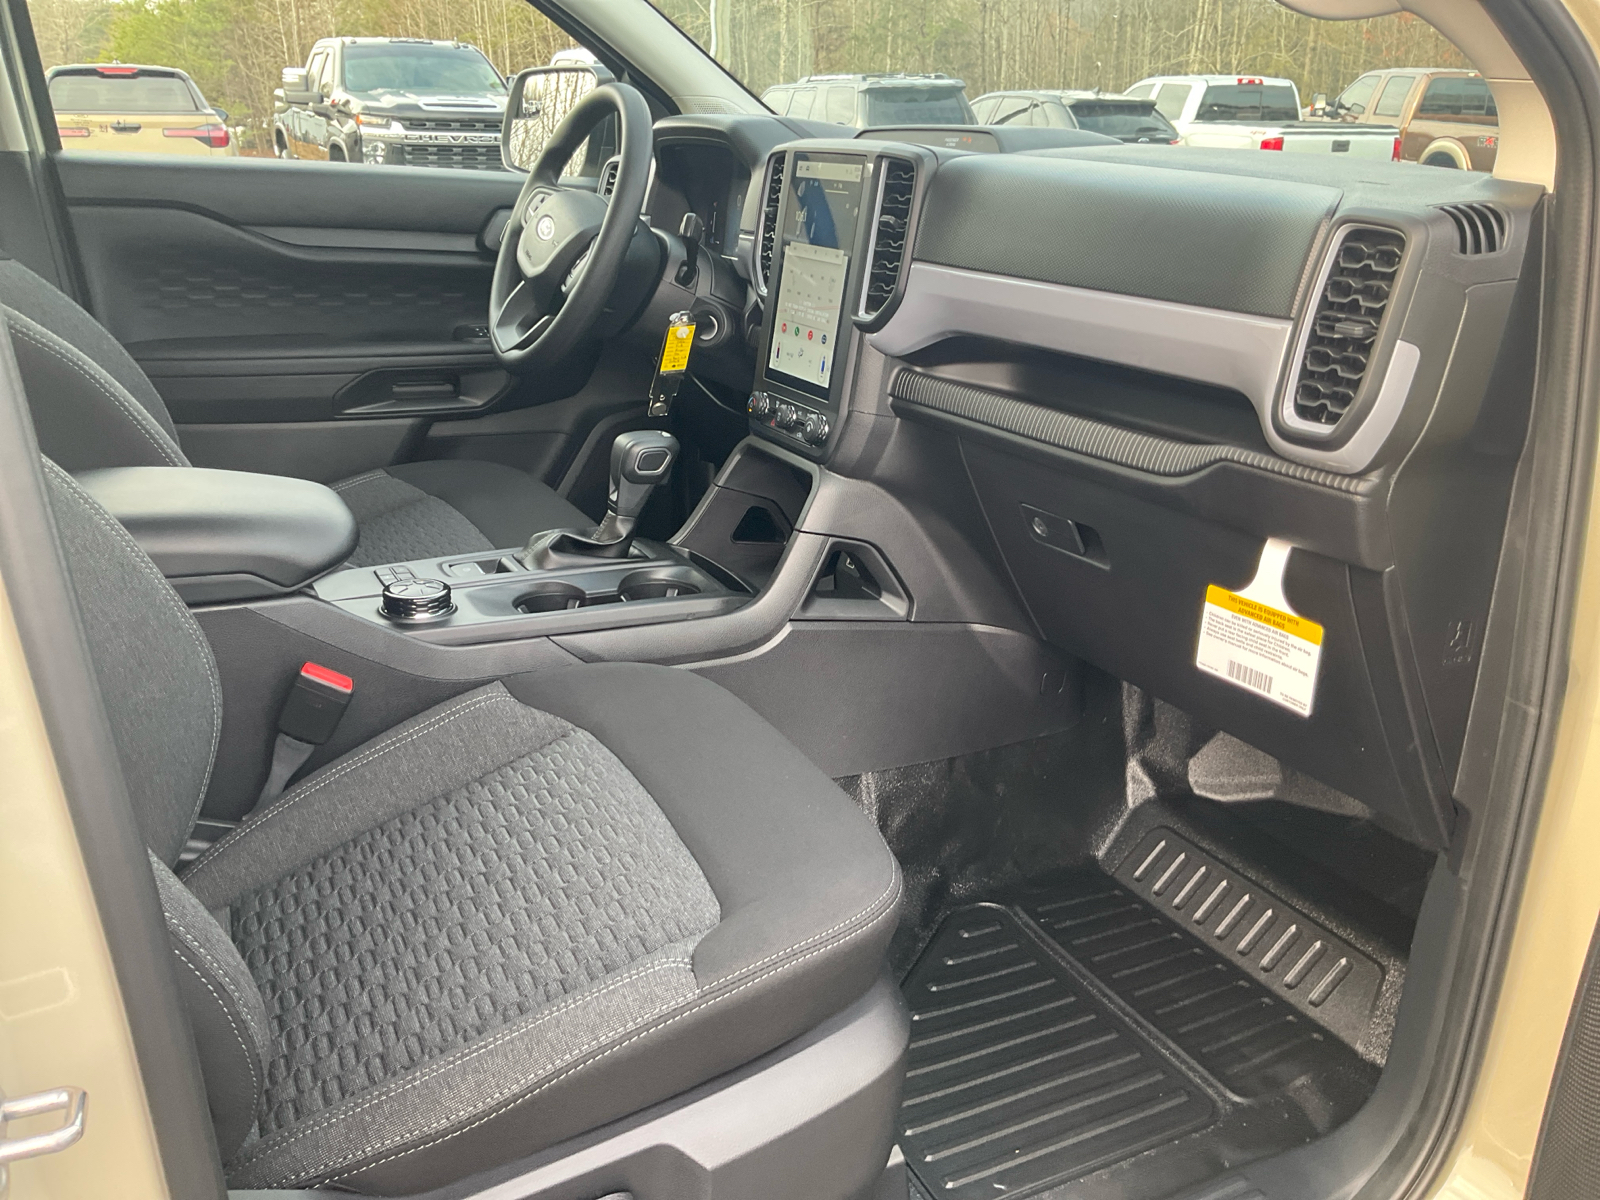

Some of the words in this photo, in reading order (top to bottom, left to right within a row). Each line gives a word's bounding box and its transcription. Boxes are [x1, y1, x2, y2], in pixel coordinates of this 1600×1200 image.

[1228, 595, 1238, 604] THIS
[1238, 599, 1257, 611] VEHICLE
[1264, 608, 1286, 622] EQUIPPED
[1287, 617, 1299, 627] WITH
[1238, 606, 1263, 621] ADVANCED
[1272, 619, 1285, 629] BAGS
[1252, 622, 1271, 633] ADVANCED
[1279, 632, 1289, 640] BAGS
